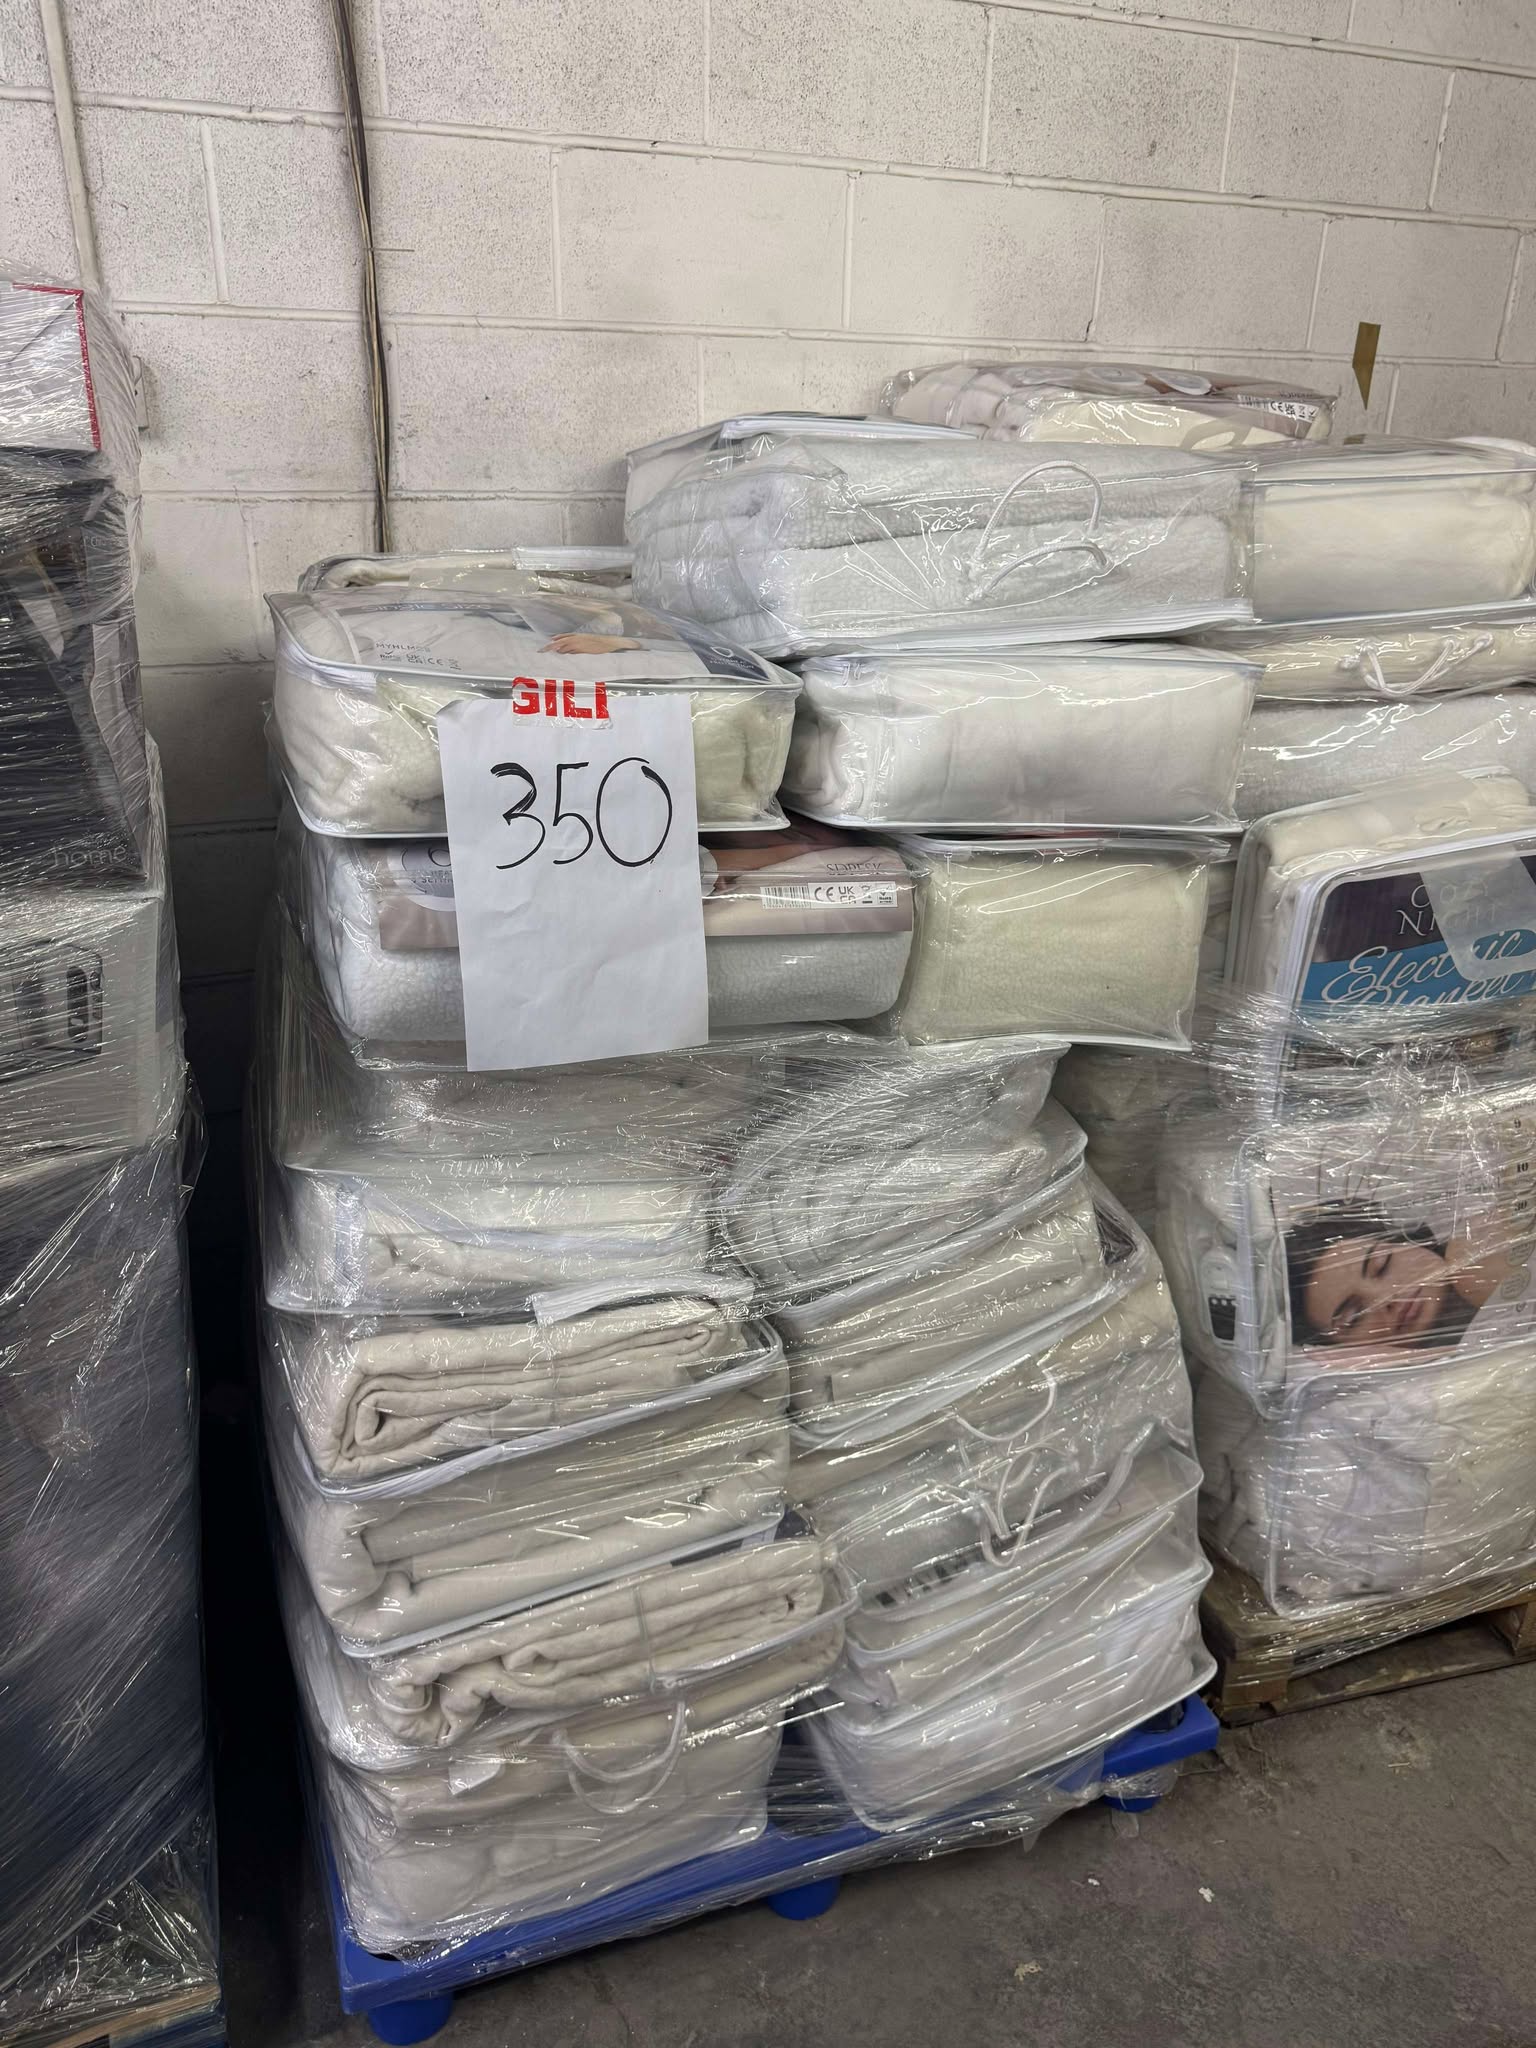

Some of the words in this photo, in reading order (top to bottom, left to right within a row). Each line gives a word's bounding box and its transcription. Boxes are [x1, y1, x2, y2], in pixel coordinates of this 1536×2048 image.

[428, 657, 444, 665] CE
[490, 757, 673, 869] 350
[814, 886, 835, 902] CE
[838, 886, 855, 895] UK
[1321, 931, 1523, 1004] Electic
